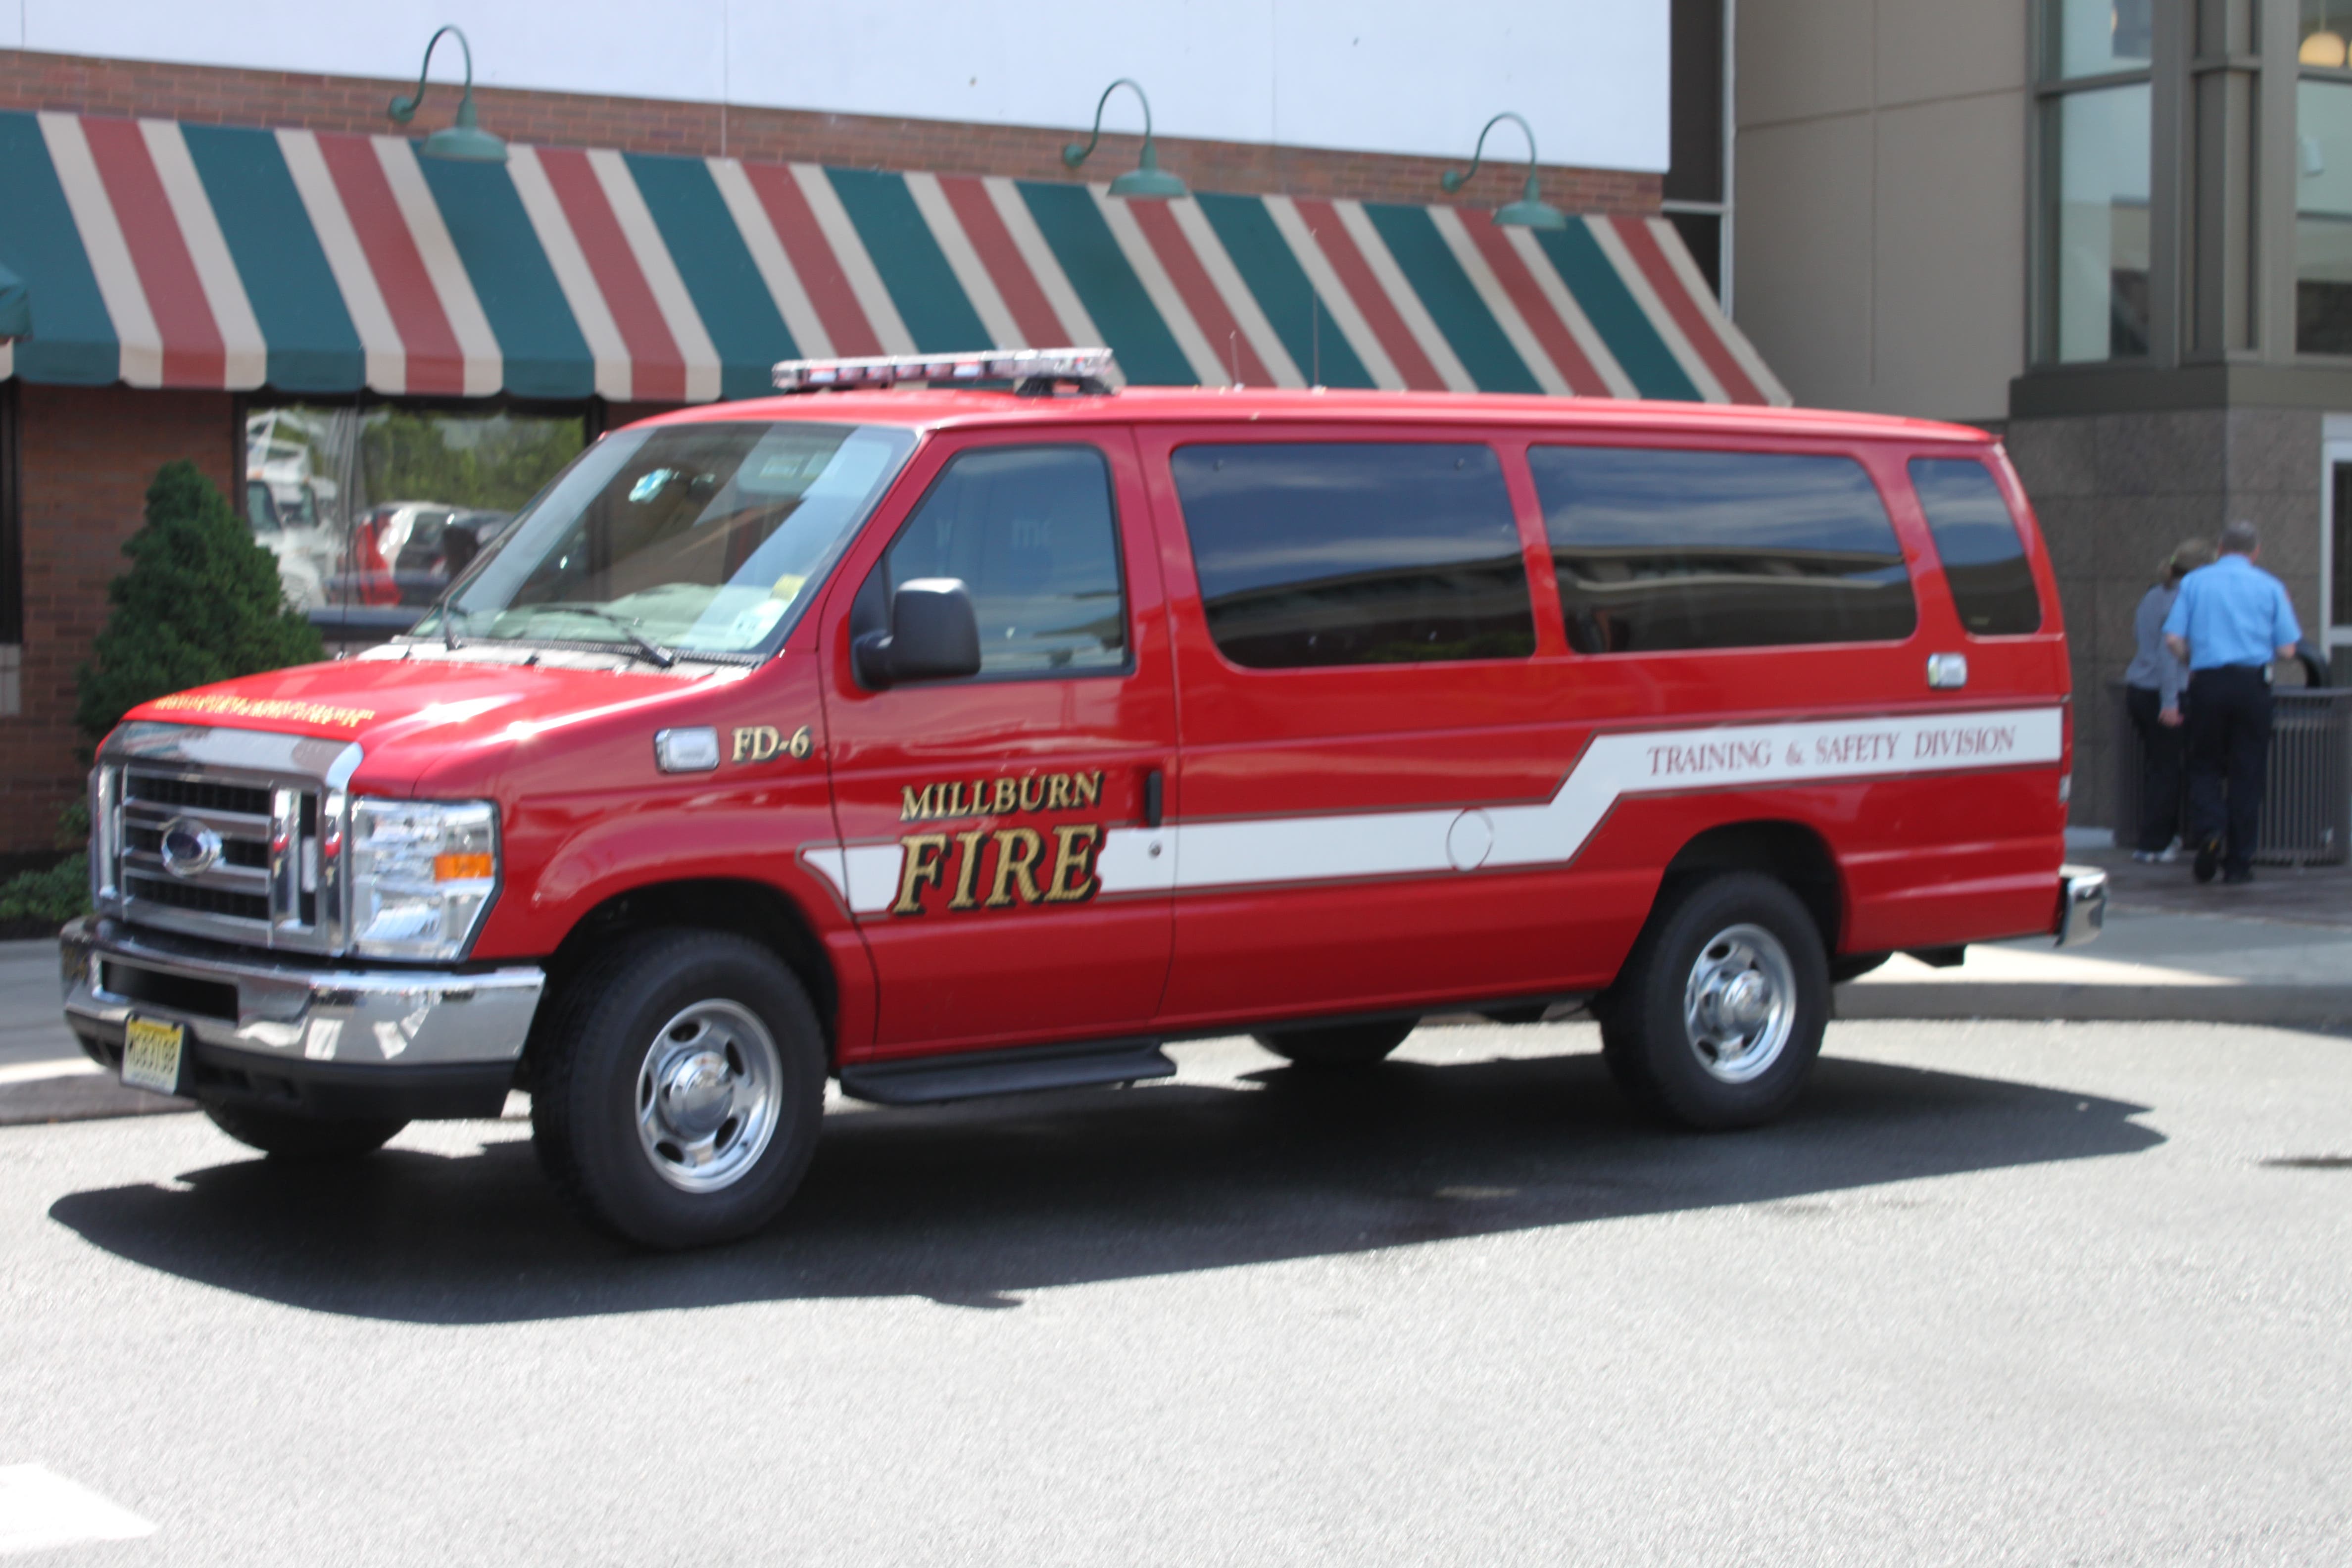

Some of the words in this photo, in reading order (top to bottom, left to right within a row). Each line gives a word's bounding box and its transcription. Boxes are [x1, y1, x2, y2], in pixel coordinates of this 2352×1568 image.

[731, 724, 813, 762] FD-6
[1646, 739, 1772, 776] TRAINING
[1784, 739, 1806, 767] &
[1815, 731, 1901, 765] SAFETY
[1912, 725, 2017, 759] DIVISION
[900, 770, 1104, 822] MILLBURN
[892, 823, 1103, 916] FIRE
